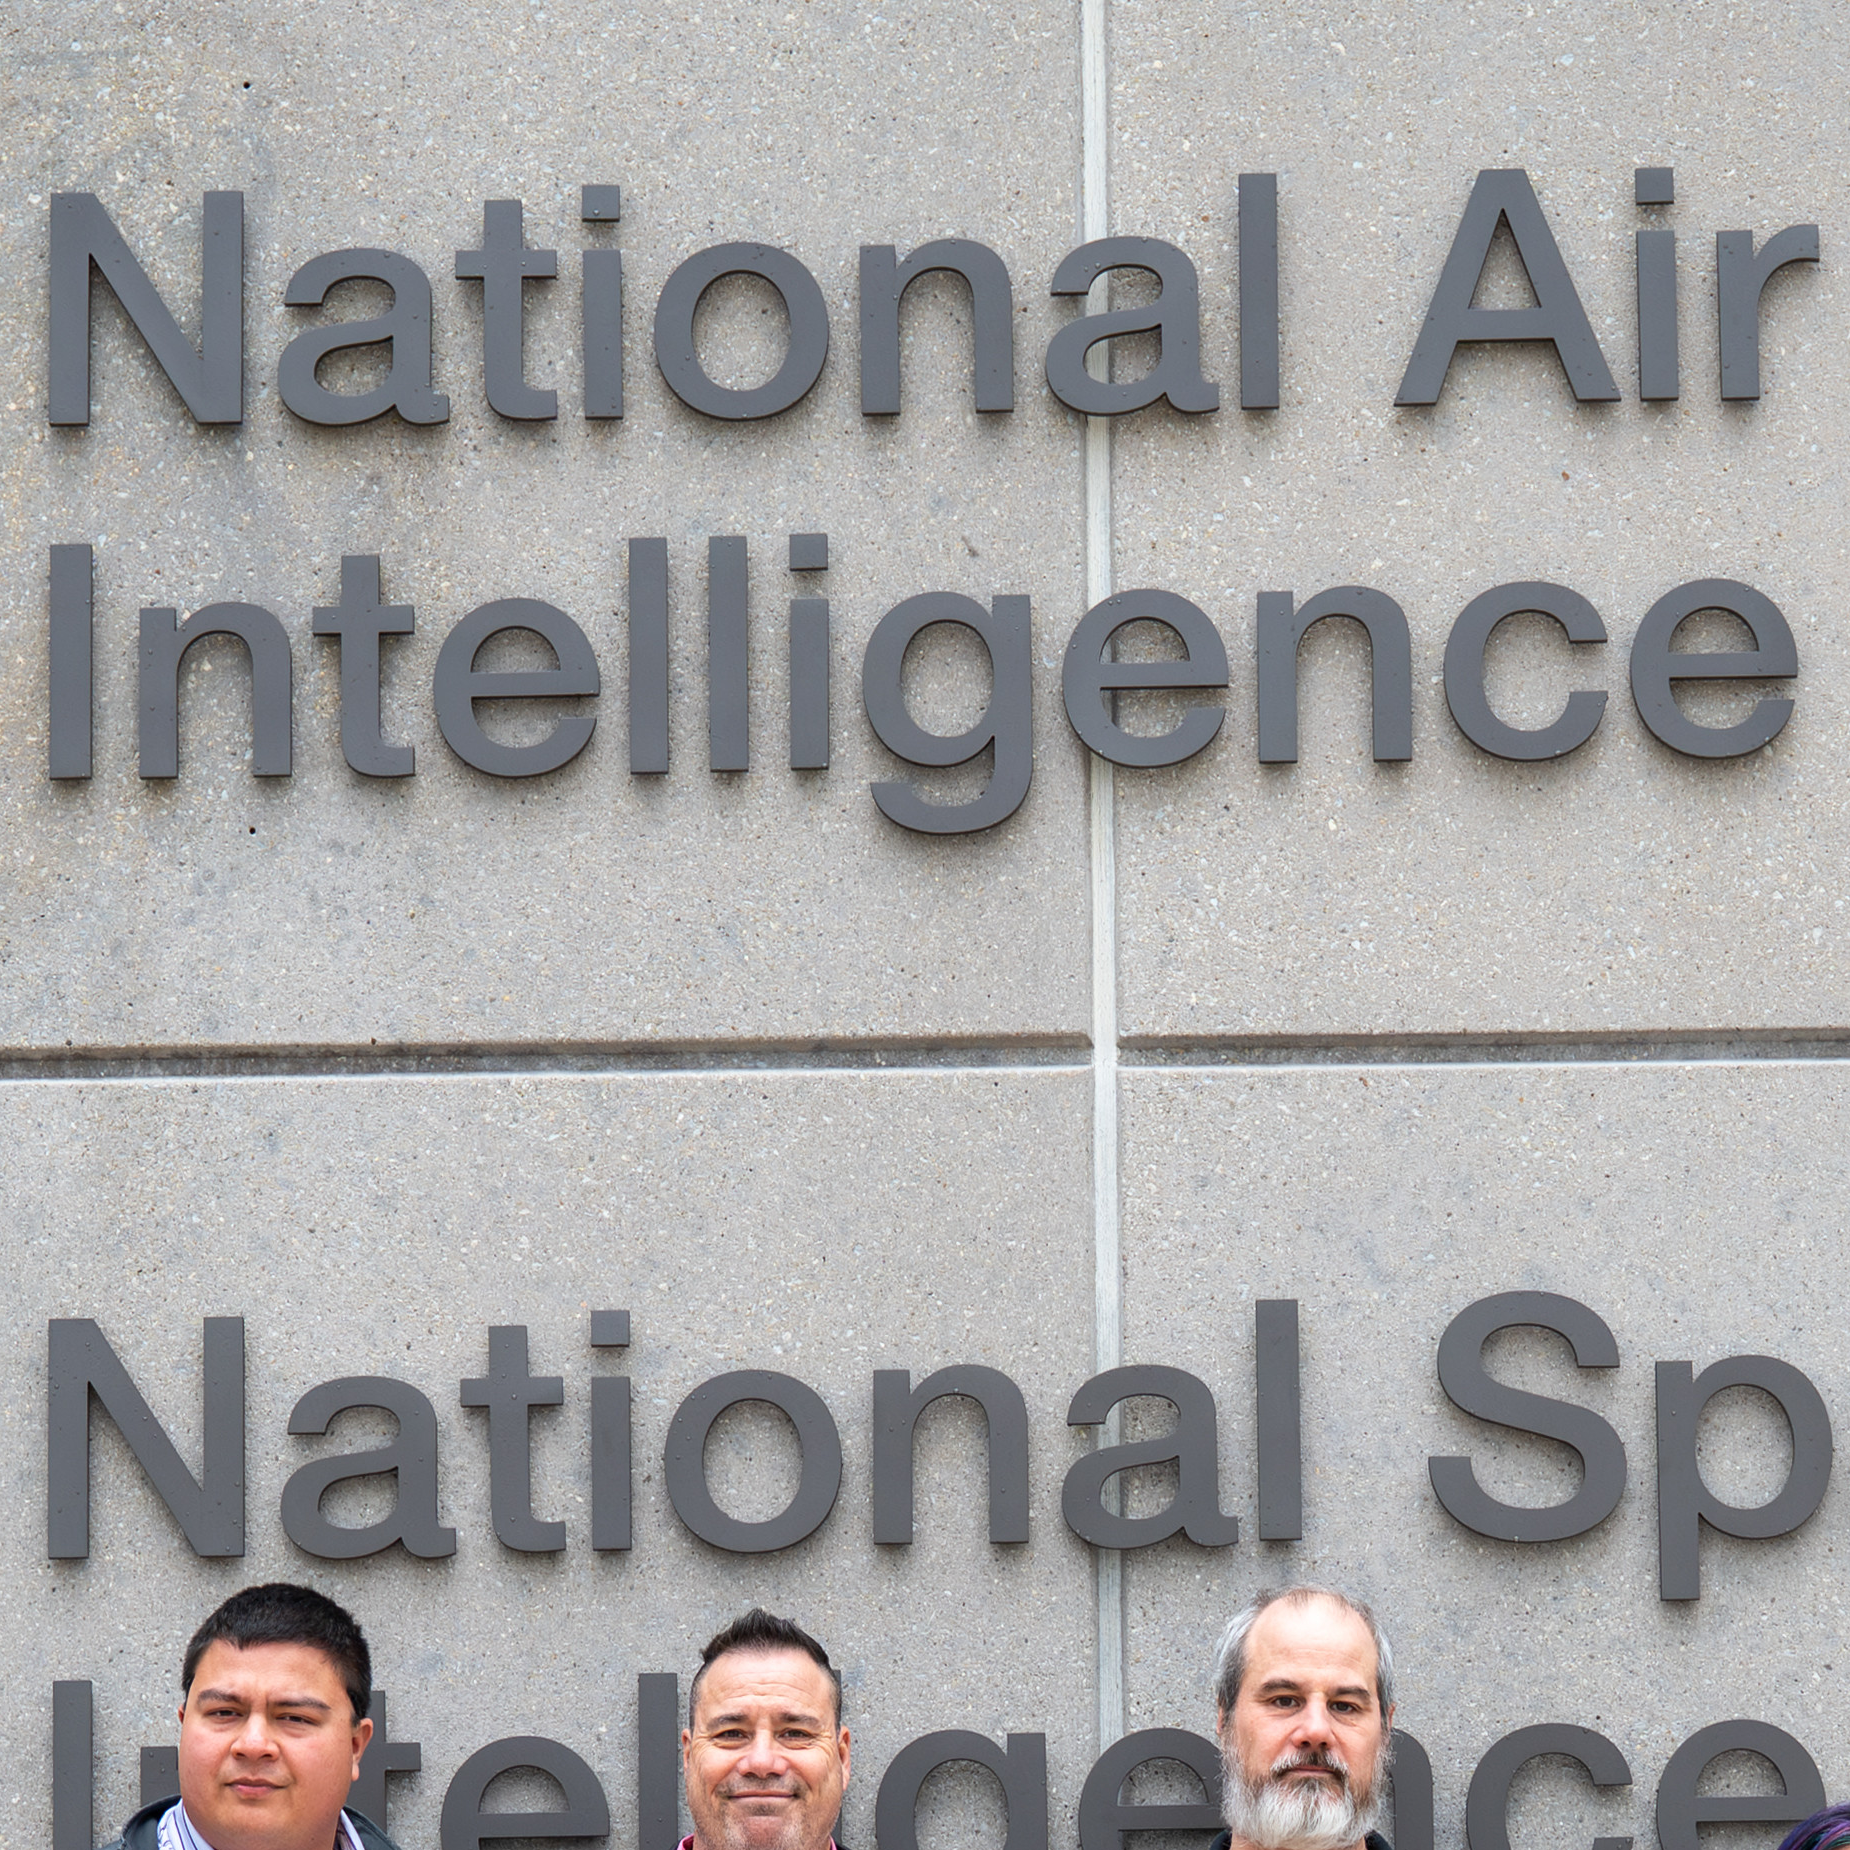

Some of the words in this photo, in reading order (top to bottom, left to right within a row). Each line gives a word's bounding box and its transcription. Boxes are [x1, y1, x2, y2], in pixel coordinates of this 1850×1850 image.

[48, 172, 1280, 426] National
[1393, 166, 1821, 407] Air
[48, 532, 1799, 834] Intelligence
[47, 1298, 1303, 1561] National
